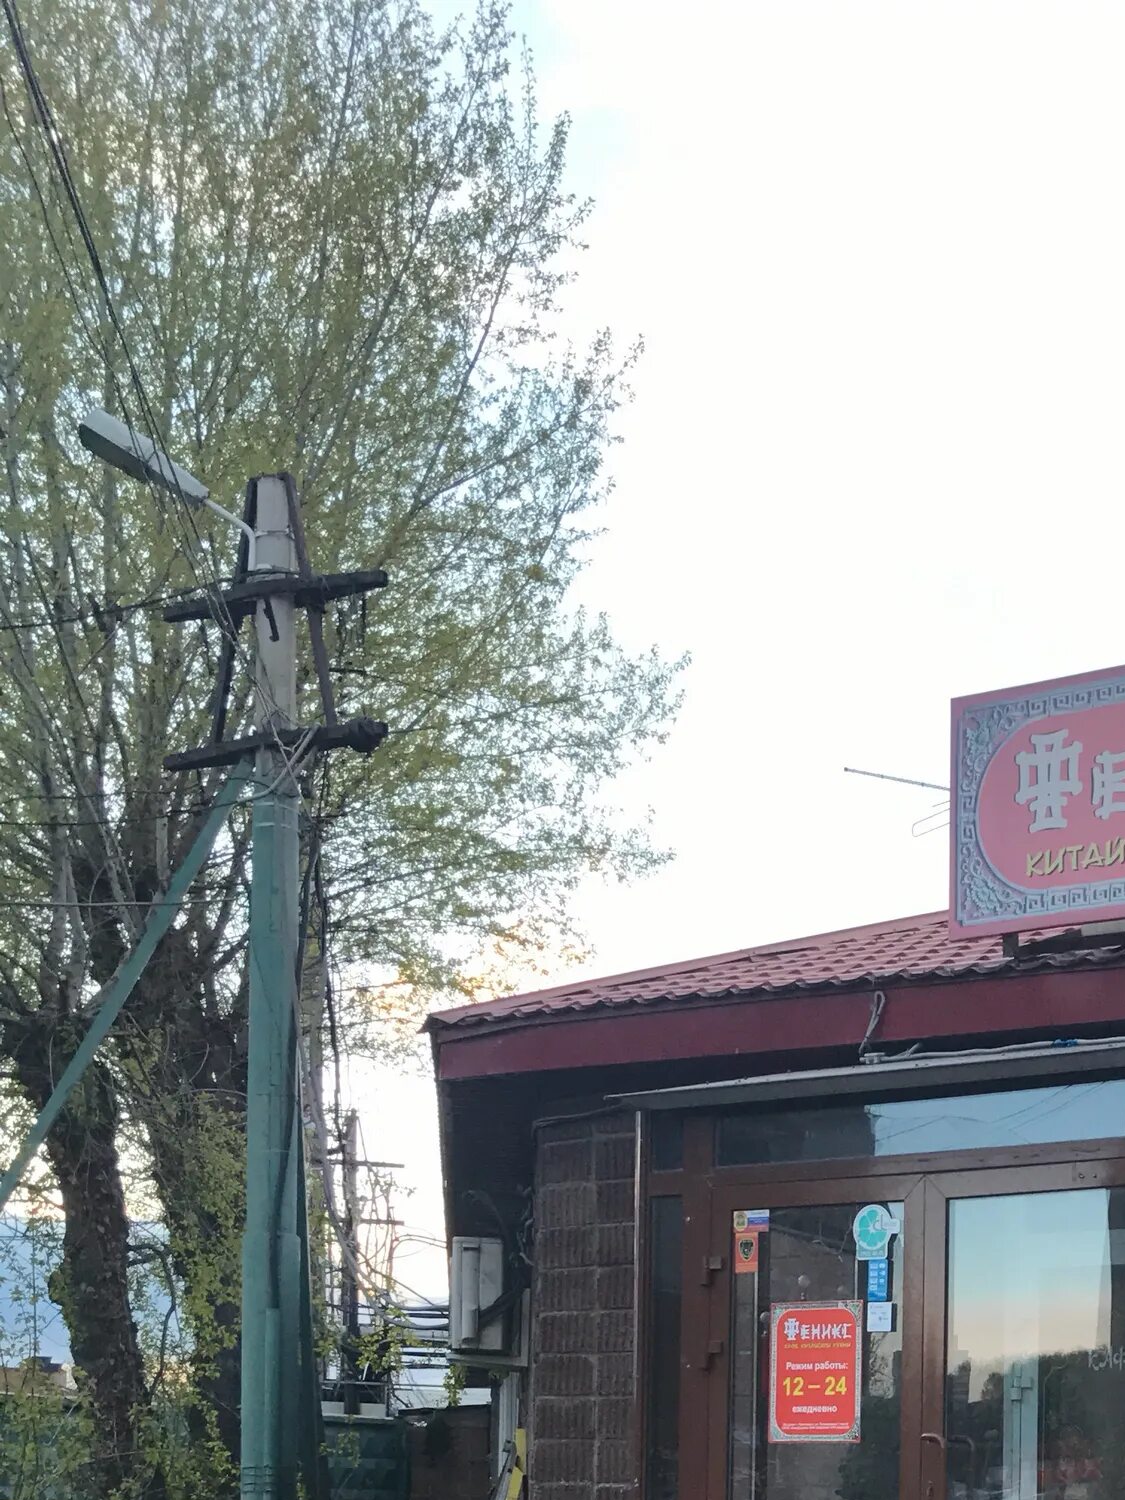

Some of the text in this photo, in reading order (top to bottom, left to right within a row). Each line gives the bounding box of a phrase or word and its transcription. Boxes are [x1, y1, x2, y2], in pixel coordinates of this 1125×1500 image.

[785, 1361, 849, 1372] Режим работы:
[783, 1376, 804, 1396] 12
[824, 1376, 847, 1396] 24
[792, 1404, 838, 1414] ежедневно
